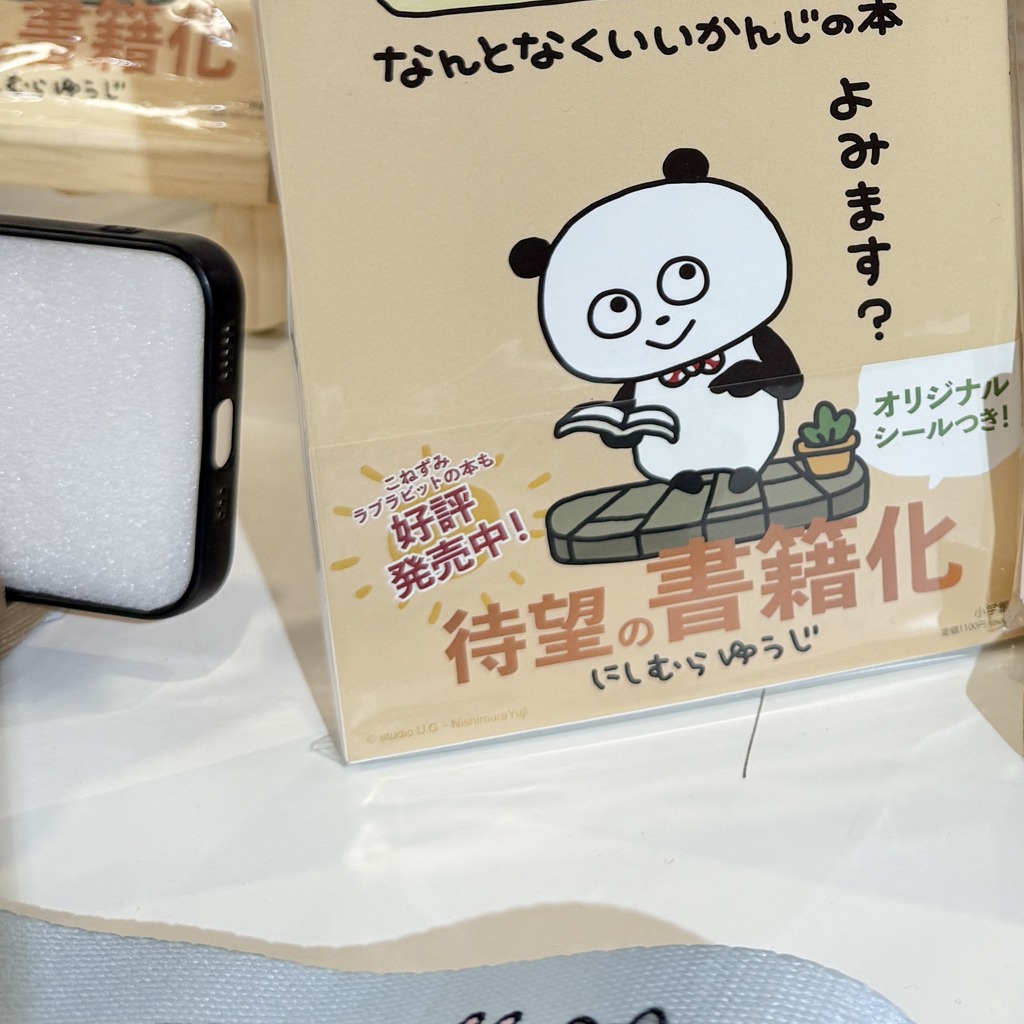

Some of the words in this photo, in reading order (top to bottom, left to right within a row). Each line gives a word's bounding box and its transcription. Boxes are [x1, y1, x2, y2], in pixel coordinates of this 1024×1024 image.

[829, 77, 892, 341] よみます？
[873, 376, 1010, 418] オリジナル
[353, 451, 495, 525] ラブラビットの本も
[383, 453, 451, 492] こねずみ
[390, 485, 477, 550] 好評
[387, 510, 530, 601] 発売中！
[442, 501, 963, 684] 待望の書籍化
[591, 625, 819, 690] にしむらゆうじ
